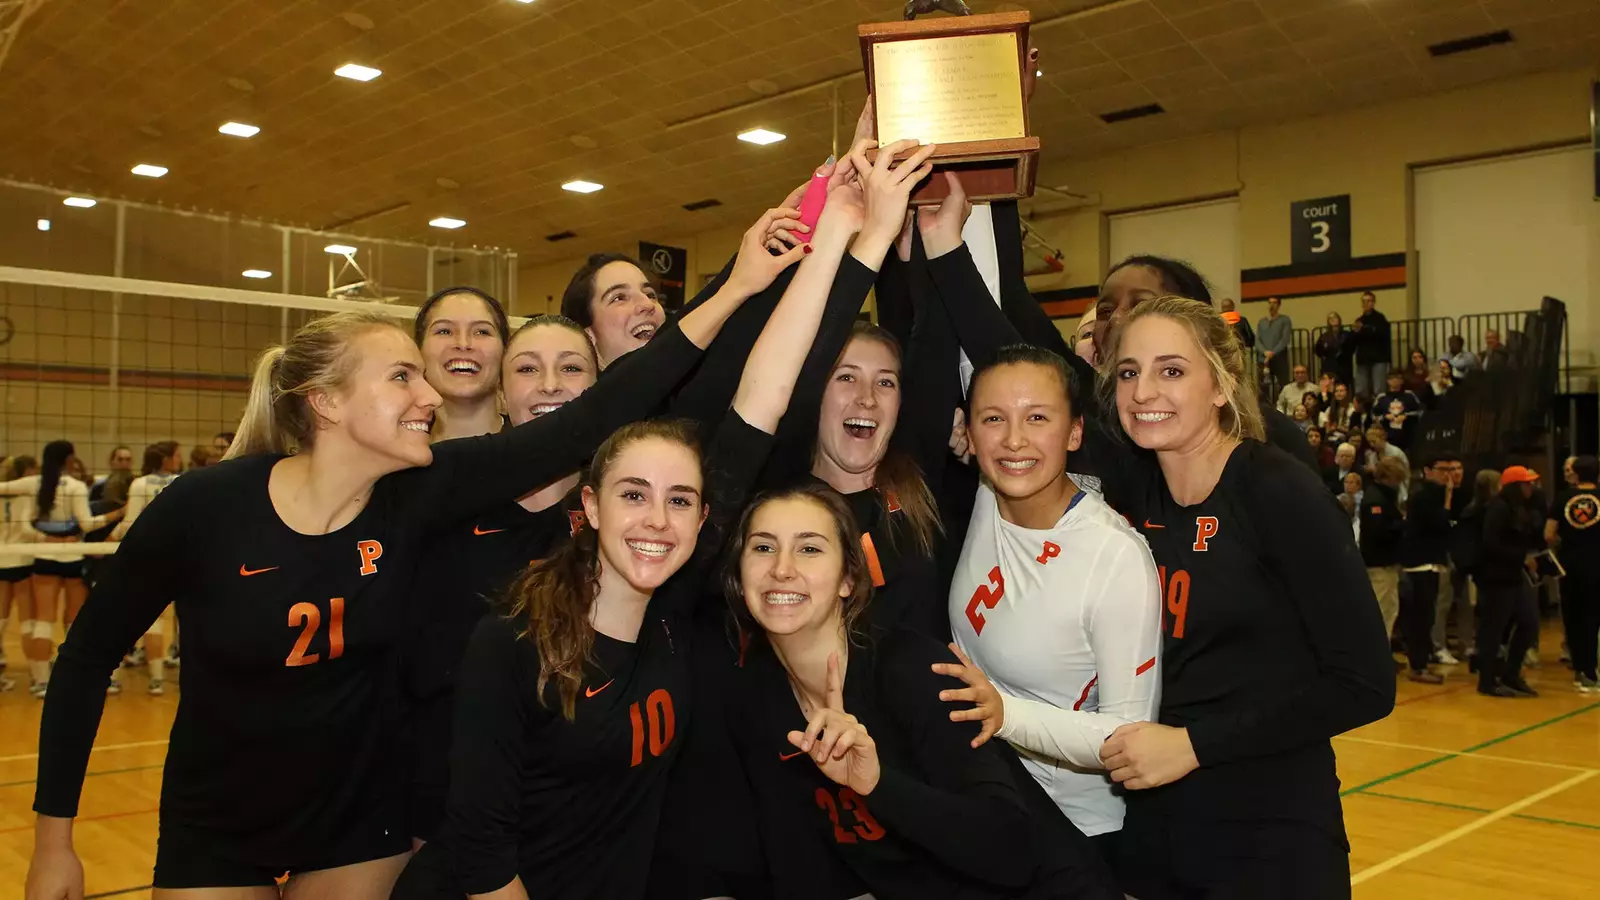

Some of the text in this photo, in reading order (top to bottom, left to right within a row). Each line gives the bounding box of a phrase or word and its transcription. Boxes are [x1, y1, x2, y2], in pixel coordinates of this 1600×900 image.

[1303, 203, 1338, 218] court
[1311, 221, 1331, 253] 3
[1036, 540, 1062, 565] P
[1193, 516, 1219, 552] P
[357, 539, 383, 576] P
[965, 565, 1005, 637] 2
[285, 597, 344, 667] 21
[629, 688, 675, 768] 10
[815, 787, 886, 844] 23
